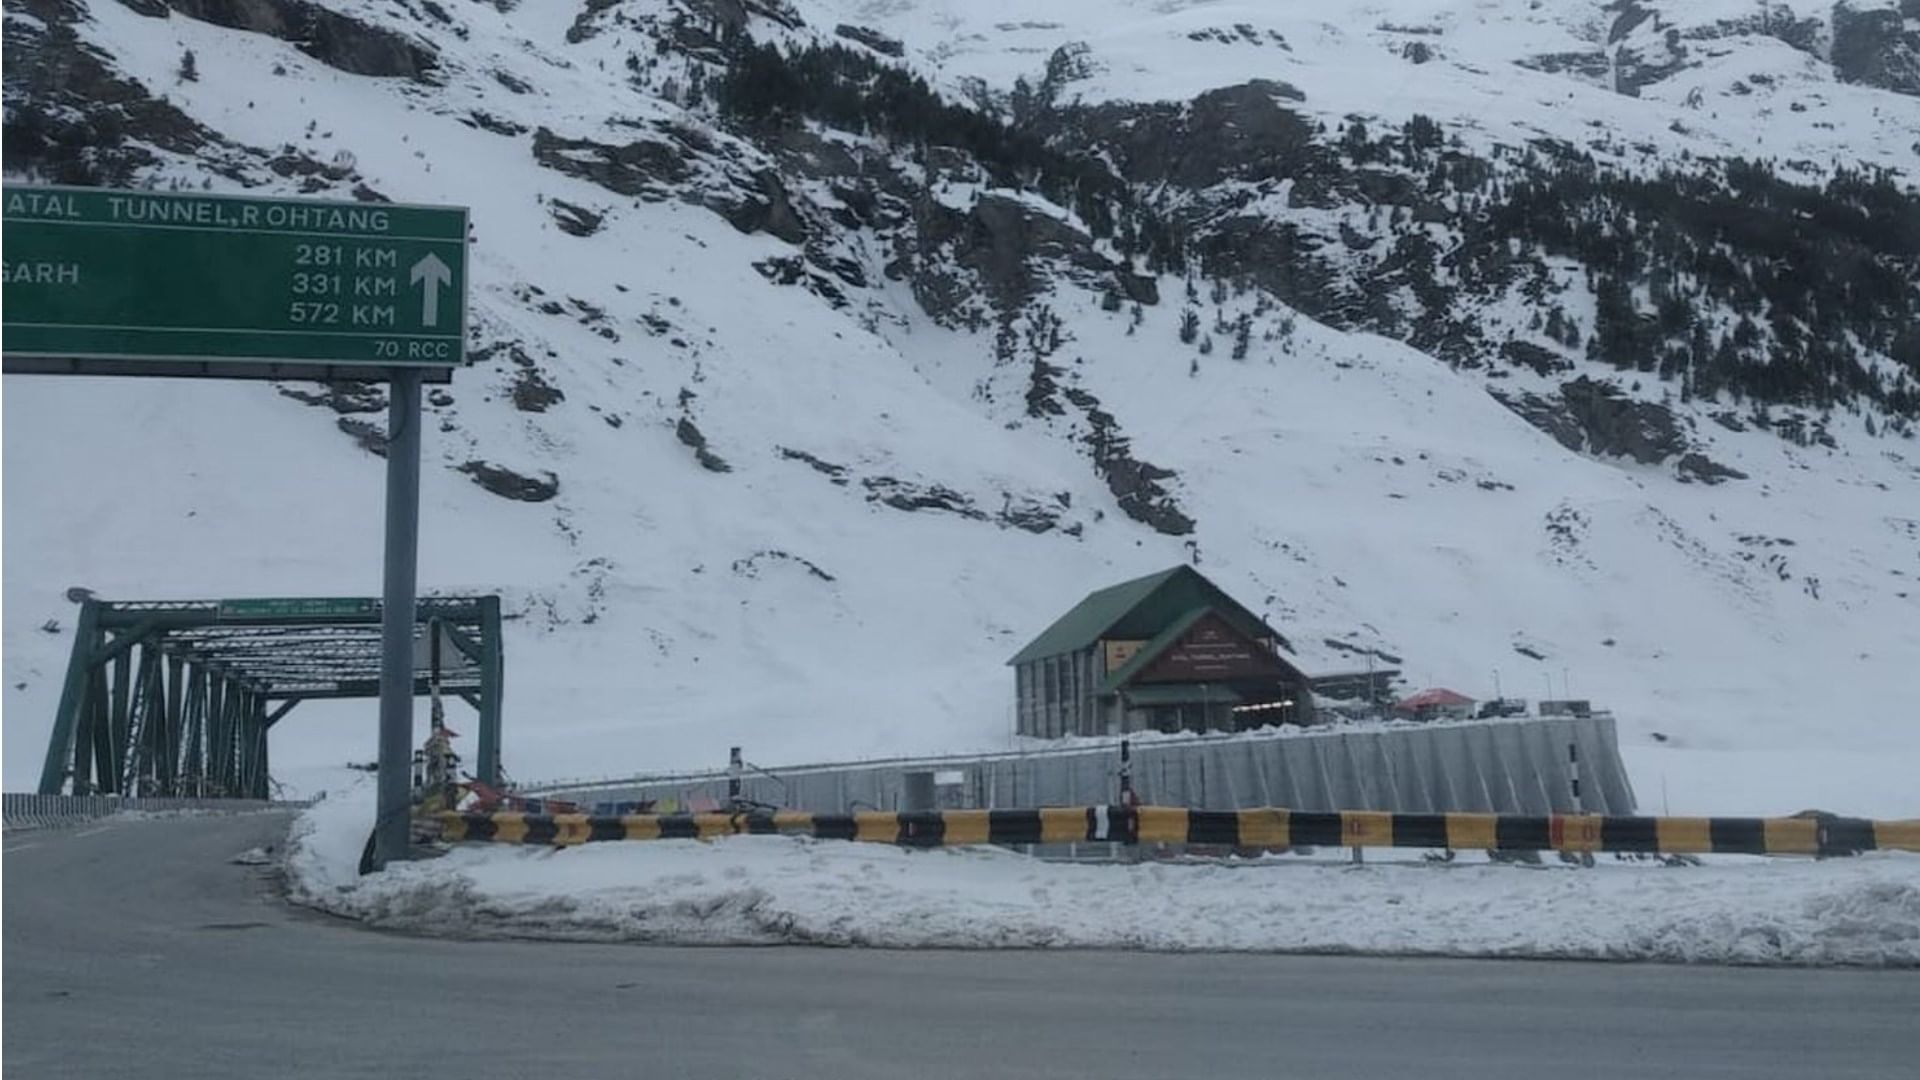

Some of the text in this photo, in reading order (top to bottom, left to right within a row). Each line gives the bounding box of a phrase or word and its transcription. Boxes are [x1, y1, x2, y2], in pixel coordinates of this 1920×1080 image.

[7, 193, 80, 216] ATAL
[296, 245, 397, 268] 281 KM
[292, 273, 341, 294] 331
[354, 276, 396, 297] KM
[290, 303, 395, 325] 572 KM
[375, 341, 449, 358] 70 RCC
